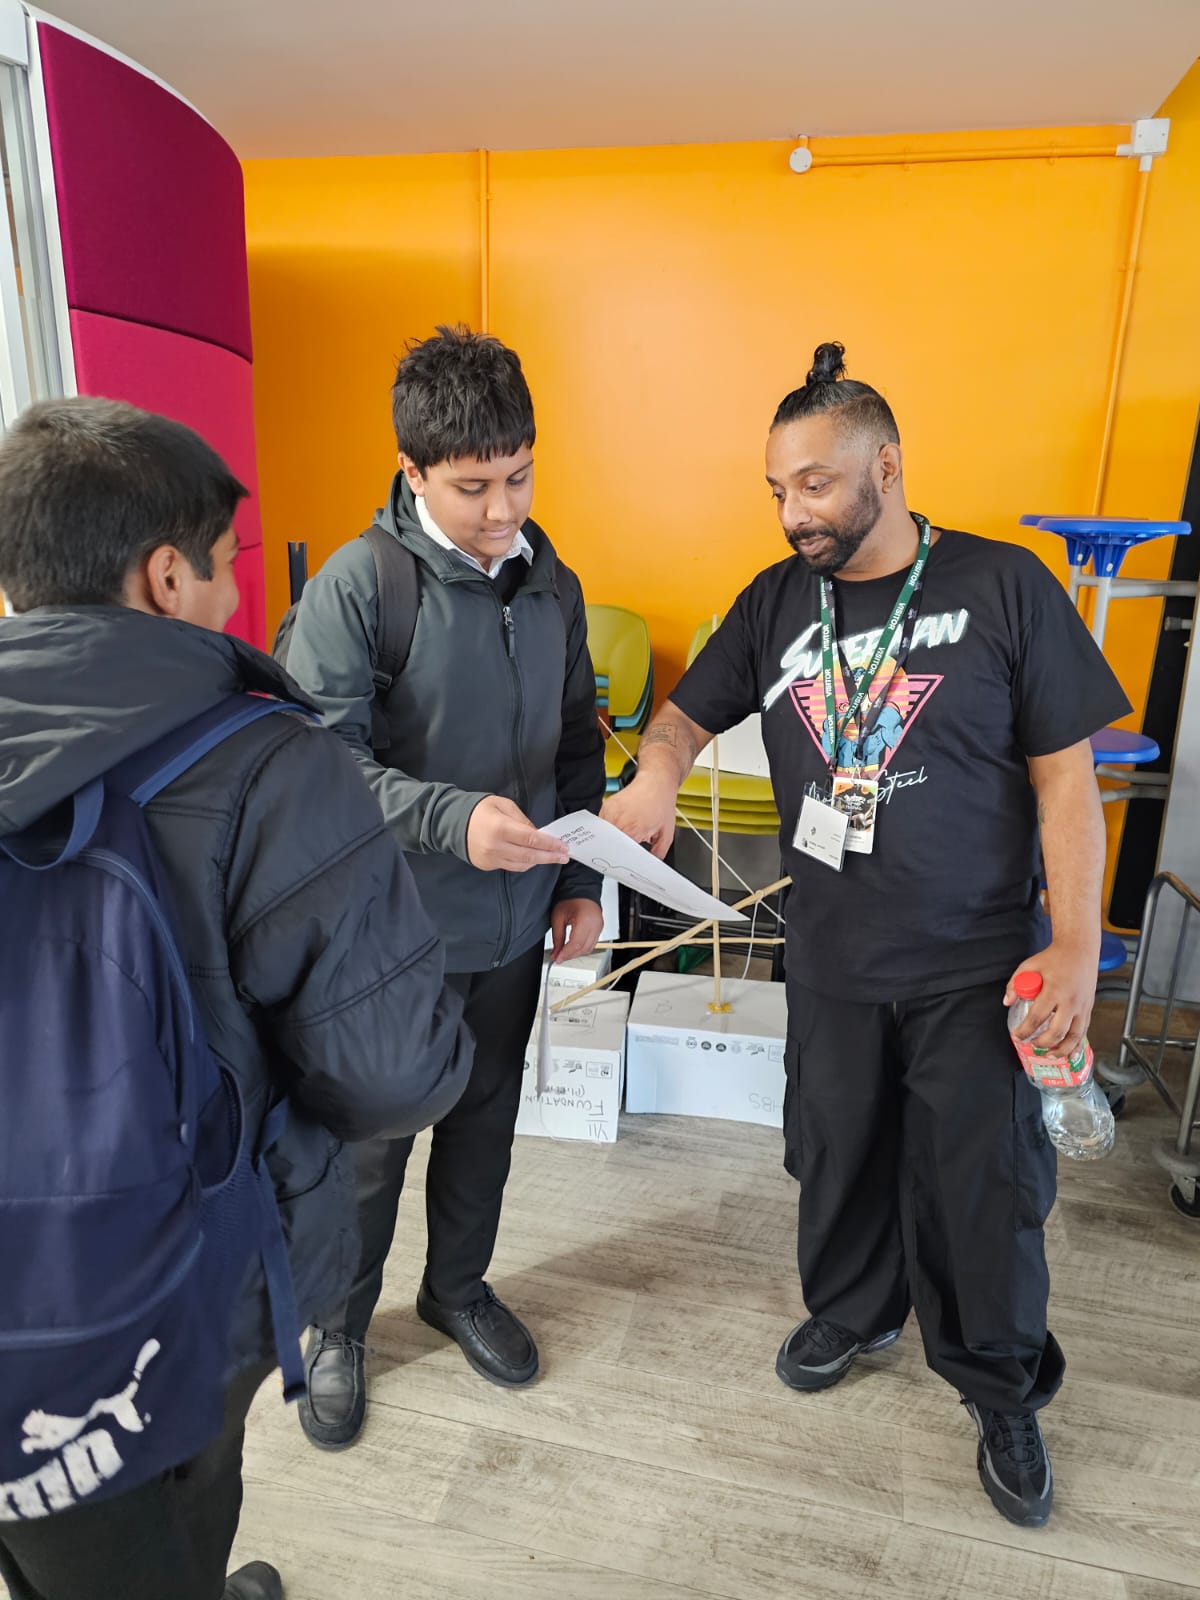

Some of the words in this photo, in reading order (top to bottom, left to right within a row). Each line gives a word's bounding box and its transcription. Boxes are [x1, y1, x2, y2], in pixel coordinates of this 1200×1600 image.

[908, 559, 924, 587] VISITOR
[888, 602, 906, 631] VISITOR
[822, 623, 831, 652] VISITOR
[868, 647, 886, 676] VISITOR
[824, 668, 833, 698] VISITOR
[846, 692, 865, 719] VISITOR
